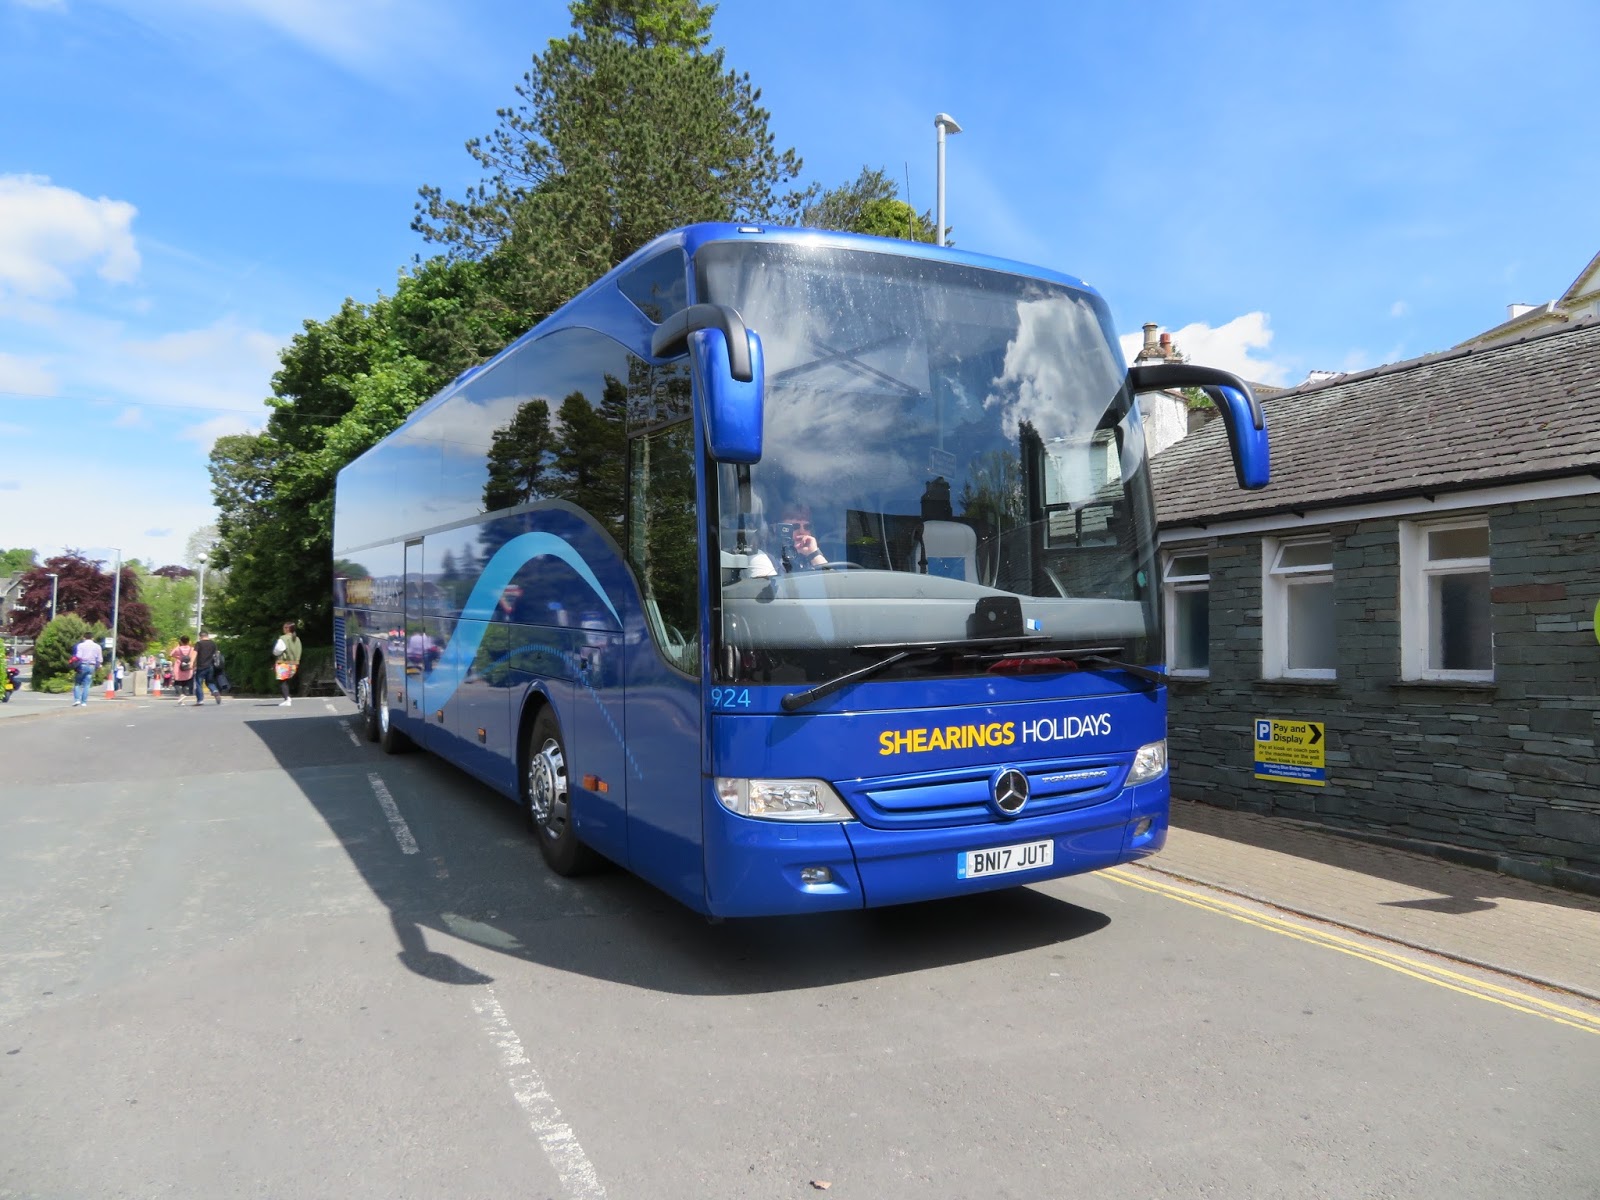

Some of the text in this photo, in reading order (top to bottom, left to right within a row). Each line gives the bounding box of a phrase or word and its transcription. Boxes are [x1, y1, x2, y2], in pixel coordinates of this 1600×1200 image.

[712, 688, 751, 708] 924
[879, 713, 1111, 756] SHEARINGS HOLIDAYS
[1259, 724, 1269, 738] P
[1274, 724, 1306, 733] Pay and
[1274, 734, 1304, 744] Display
[1042, 770, 1108, 784] TOURISMO
[974, 844, 1048, 873] BN17 JUT
